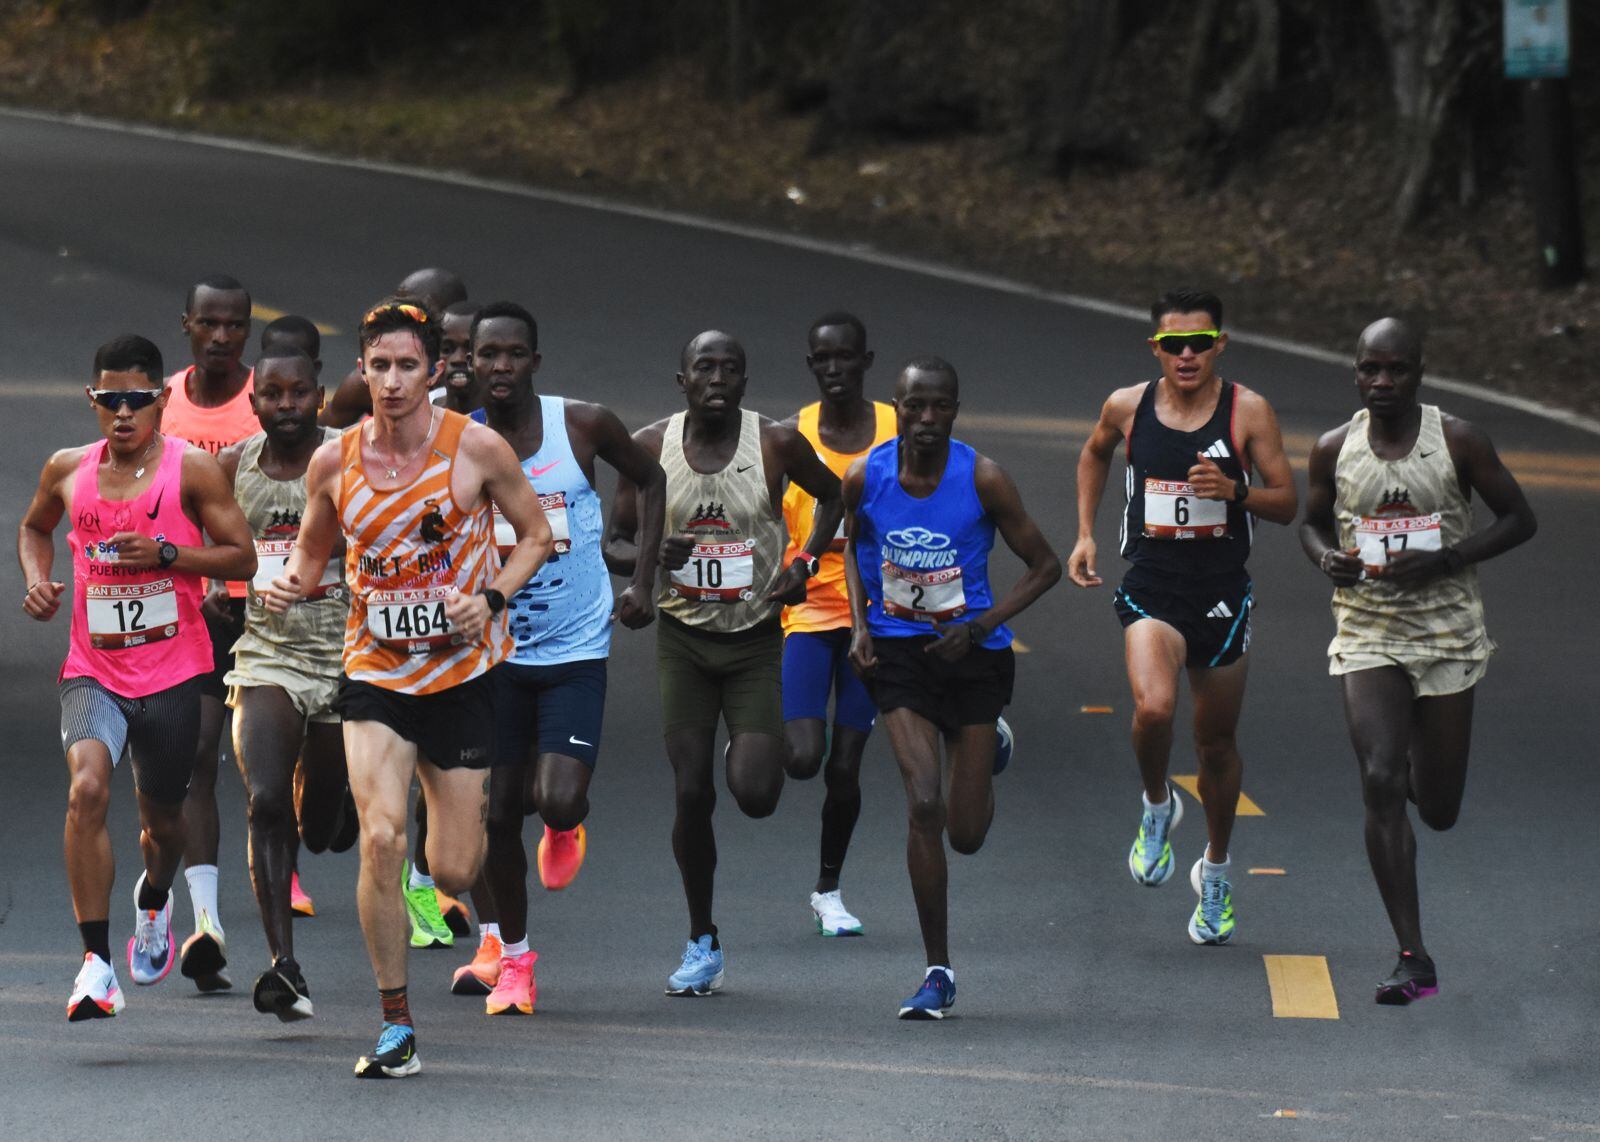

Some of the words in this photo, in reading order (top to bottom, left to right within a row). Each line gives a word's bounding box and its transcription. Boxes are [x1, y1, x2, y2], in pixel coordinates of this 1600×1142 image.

[1146, 482, 1165, 491] SAN
[539, 496, 563, 507] 024
[1175, 497, 1189, 526] 6
[255, 543, 272, 553] AN
[274, 542, 297, 552] BLA
[881, 544, 958, 569] OLYMPIKUS
[1380, 533, 1408, 564] 17
[89, 564, 138, 577] PUERTO
[418, 548, 454, 574] RUN
[693, 559, 722, 589] 10
[87, 585, 108, 596] SAN
[110, 585, 140, 596] BLAS
[143, 579, 173, 594] 2024
[911, 585, 926, 611] 2
[113, 600, 146, 632] 12
[379, 601, 450, 638] 1464
